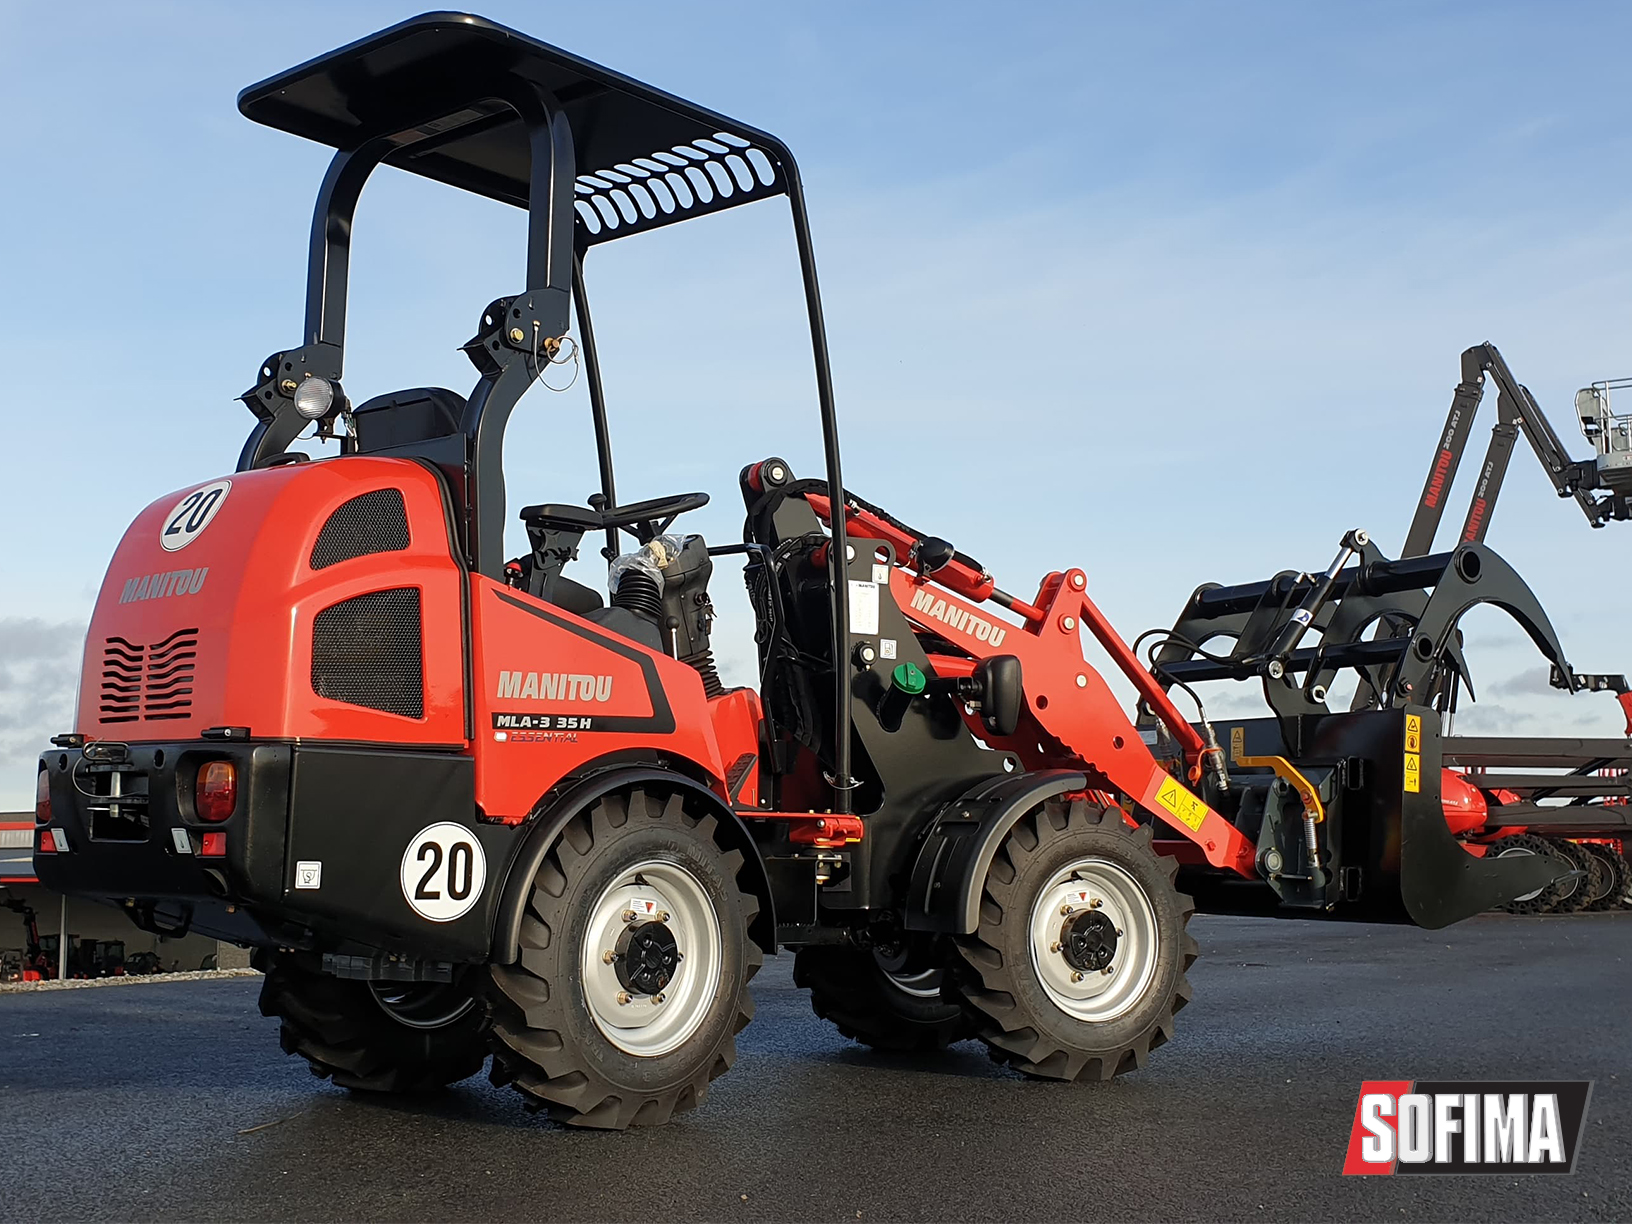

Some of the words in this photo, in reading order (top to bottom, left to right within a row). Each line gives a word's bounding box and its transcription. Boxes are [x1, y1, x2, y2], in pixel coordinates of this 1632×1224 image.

[1425, 449, 1453, 508] MANITOU
[1443, 429, 1454, 449] 200
[1450, 409, 1461, 427] ATJ
[164, 488, 223, 536] 20
[1463, 498, 1487, 542] ANITOU
[1477, 478, 1488, 498] 200
[1485, 461, 1494, 479] ATJ
[118, 567, 209, 604] MANITOU
[910, 588, 1006, 647] MANITOU
[496, 671, 613, 702] MANITOU
[497, 715, 550, 728] MLA-3
[414, 841, 474, 901] 20
